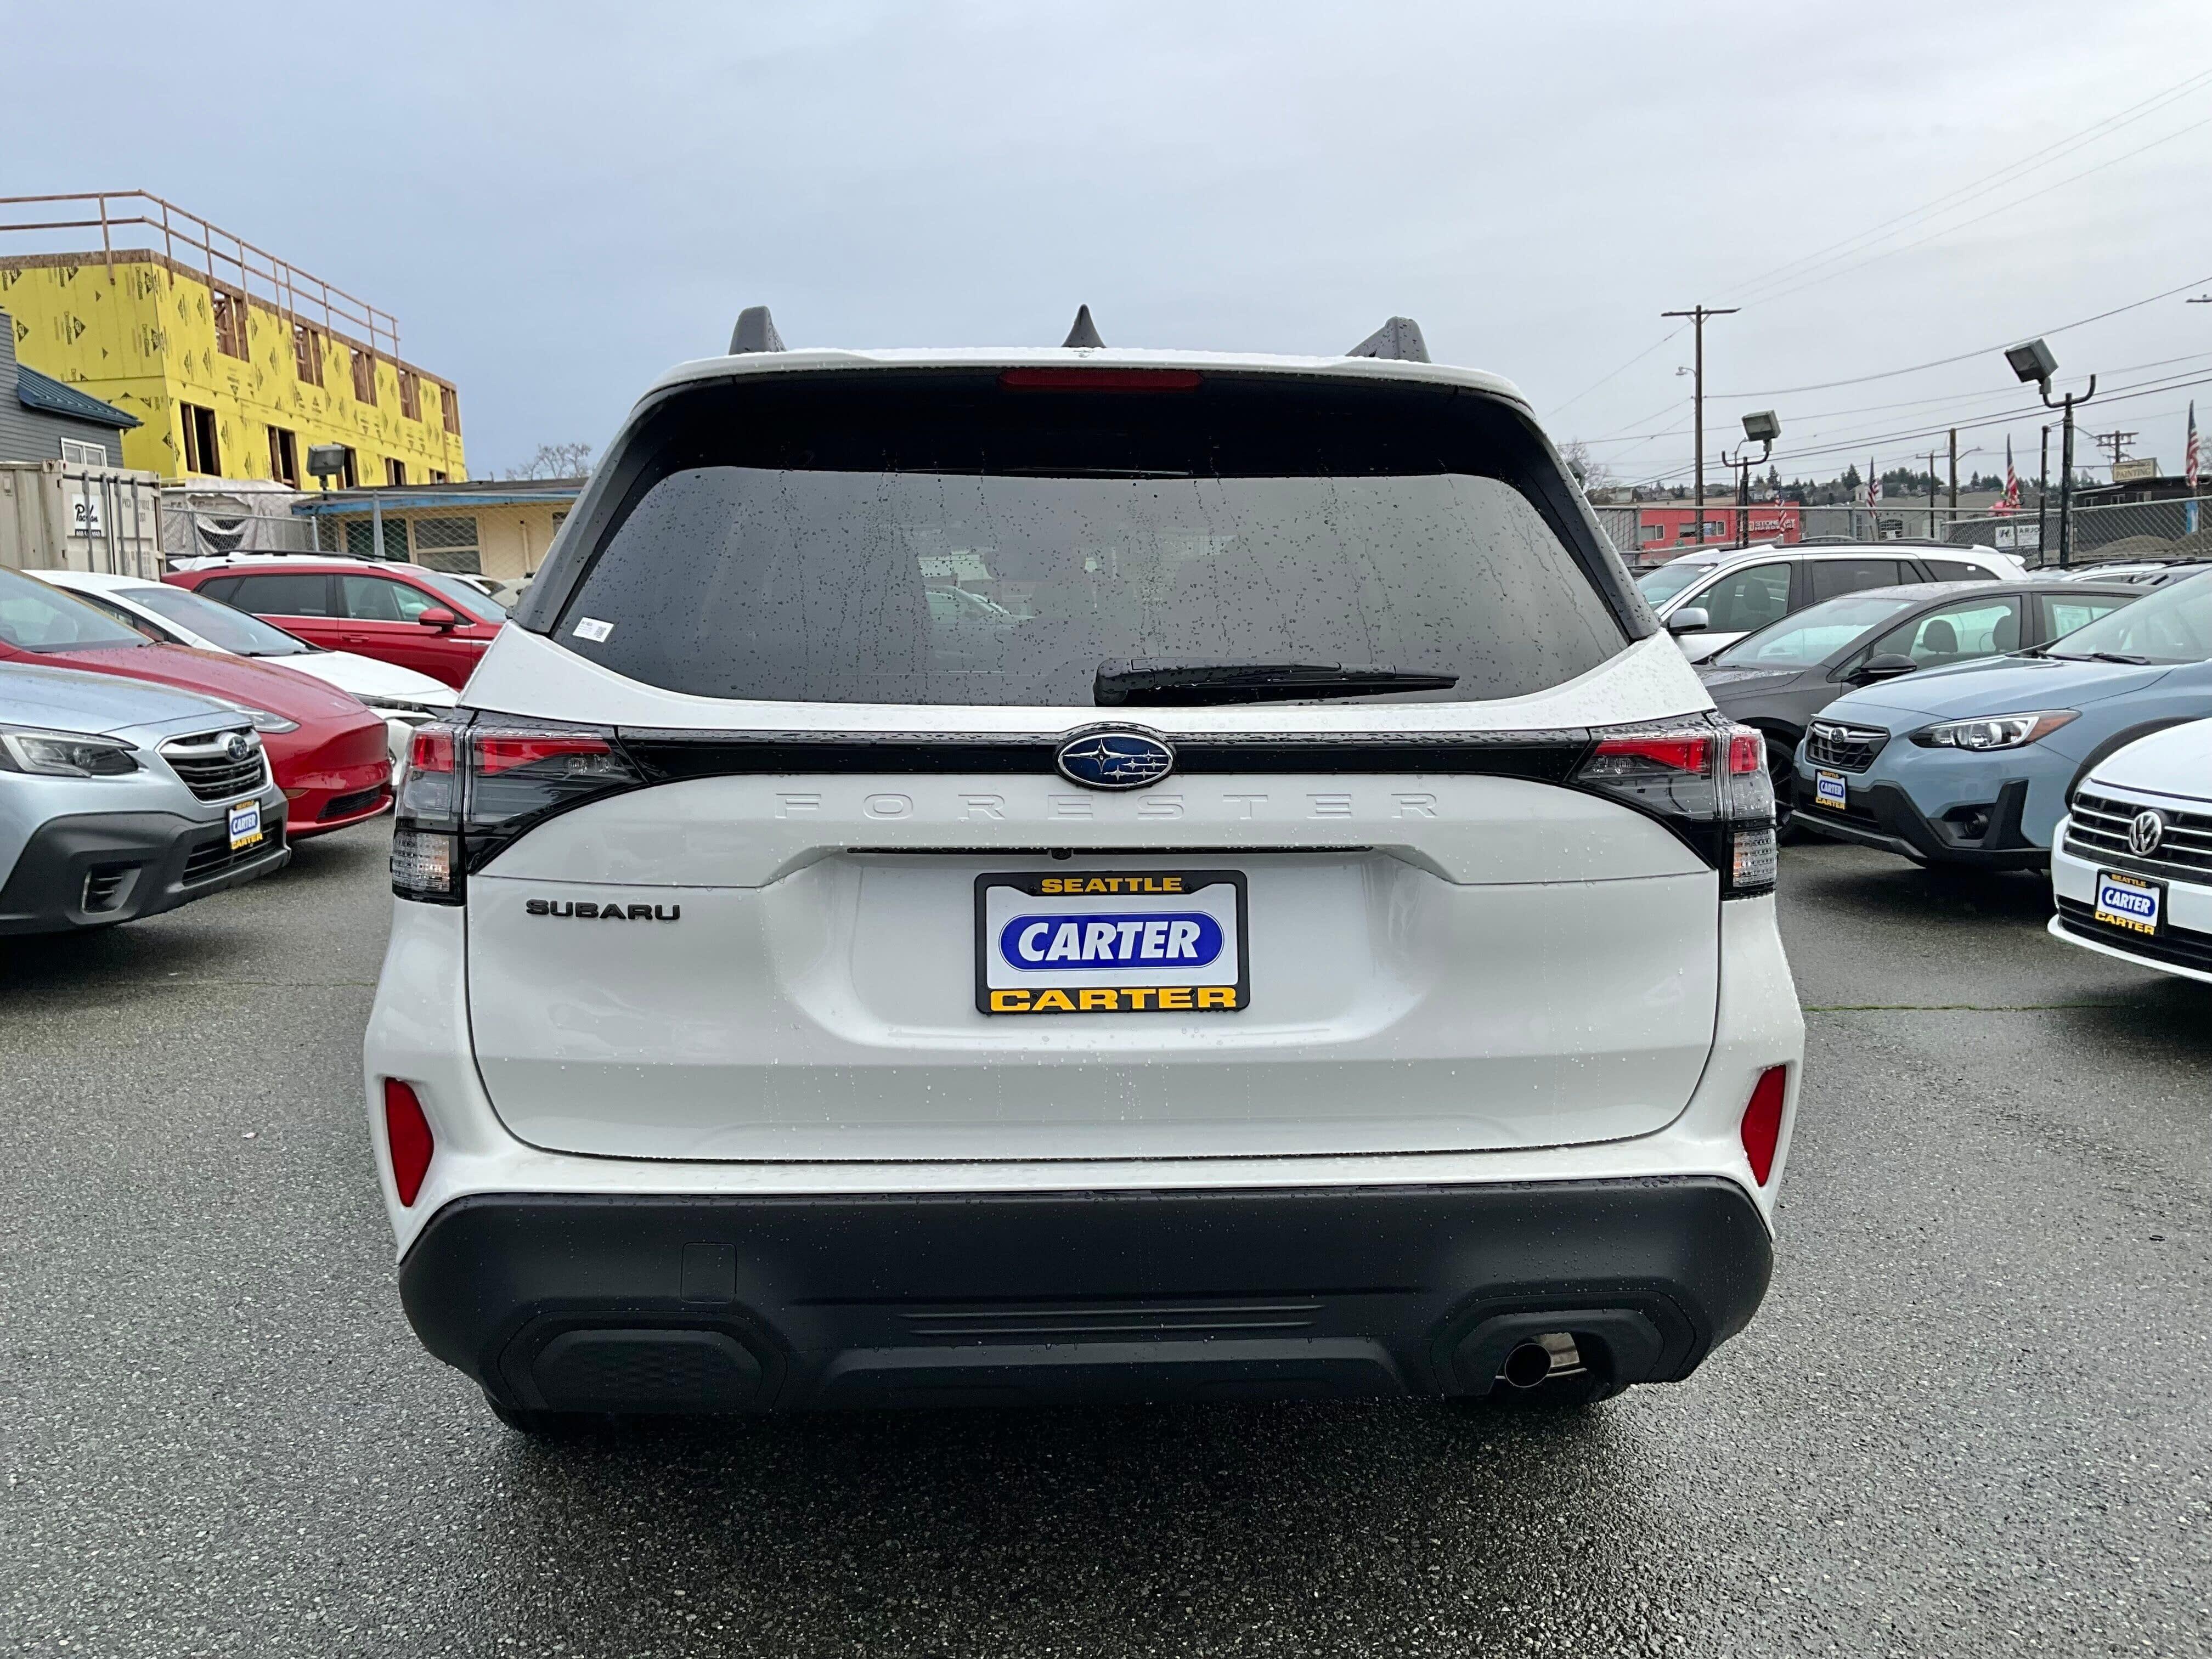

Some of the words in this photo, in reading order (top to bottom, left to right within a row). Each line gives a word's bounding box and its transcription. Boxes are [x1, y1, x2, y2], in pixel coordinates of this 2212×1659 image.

[2116, 467, 2151, 478] PAINTING
[1820, 782, 1842, 795] CARTER
[775, 793, 1438, 819] FORESTER
[1815, 797, 1845, 810] CARTER
[233, 814, 256, 833] CARTER
[231, 833, 263, 850] CARTER
[1041, 877, 1182, 893] SEATTLE
[2112, 873, 2147, 887] SEATTLE
[526, 899, 680, 920] SUBARU
[2105, 889, 2151, 913] CARTER
[2095, 911, 2155, 935] CARTER
[1018, 921, 1201, 961] CARTER
[990, 987, 1237, 1011] CARTER
